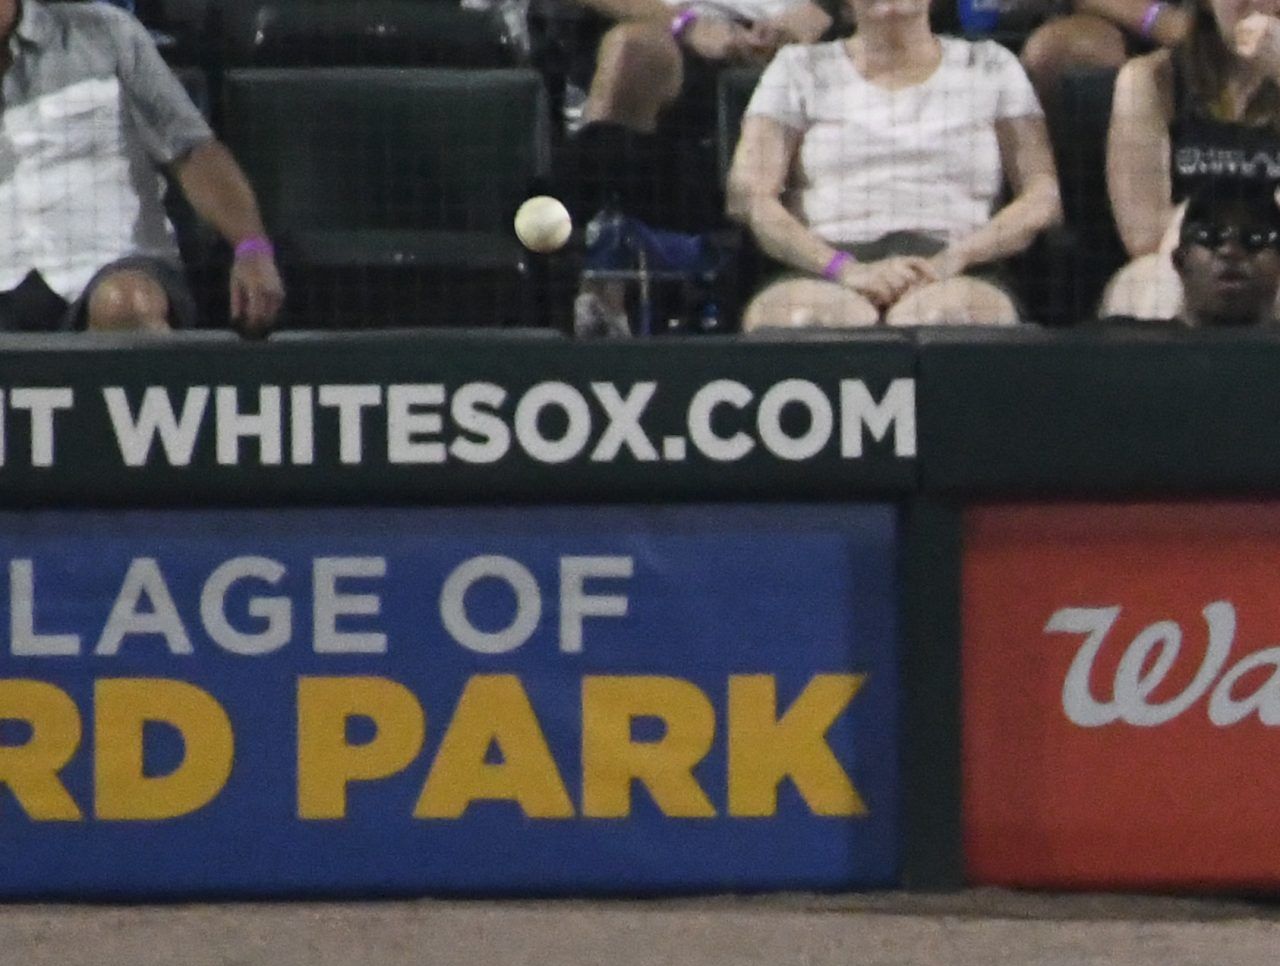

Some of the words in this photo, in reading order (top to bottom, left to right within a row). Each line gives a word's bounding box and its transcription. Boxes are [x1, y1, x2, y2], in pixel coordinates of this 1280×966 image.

[0, 385, 74, 467] T
[102, 377, 918, 467] WHITESOX.COM
[9, 554, 390, 656] LAGE
[438, 554, 634, 655] OF
[0, 676, 236, 821] RD
[297, 673, 870, 820] PARK
